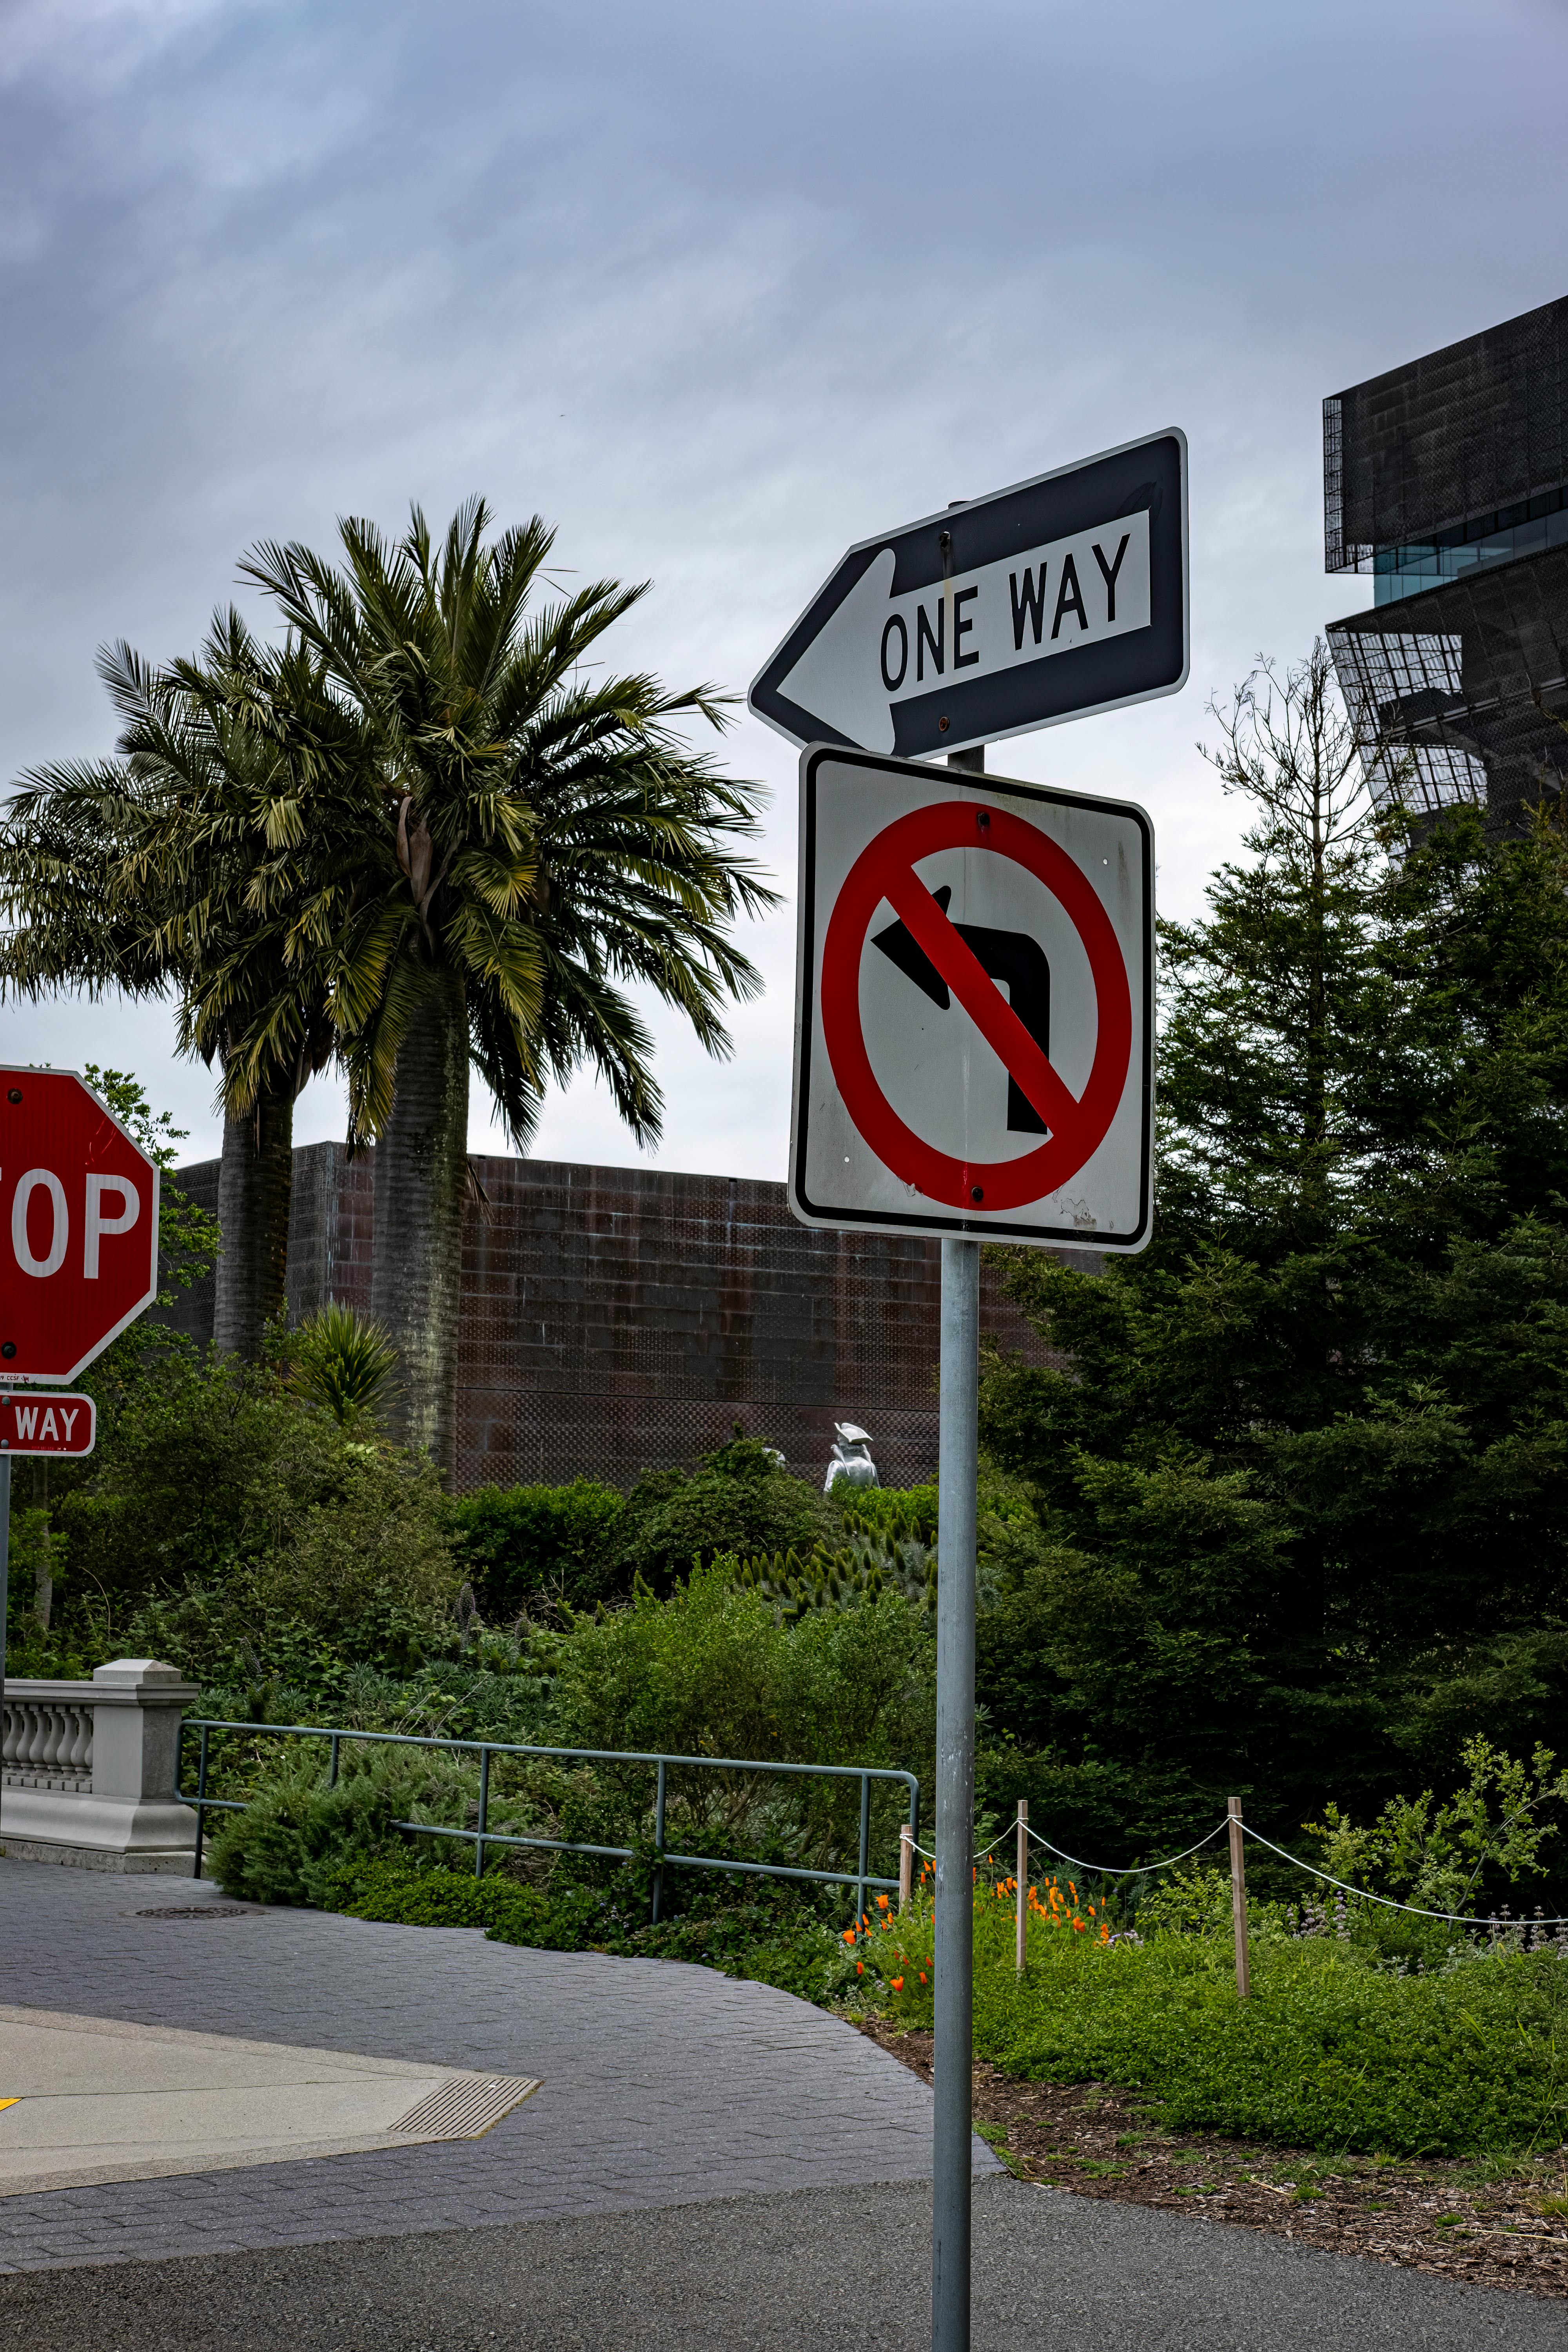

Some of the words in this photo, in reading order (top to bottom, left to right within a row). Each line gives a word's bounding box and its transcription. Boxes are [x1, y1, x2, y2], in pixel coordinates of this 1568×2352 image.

[880, 585, 979, 691] ONE
[1009, 534, 1131, 651] WAY
[0, 1167, 140, 1279] OP
[15, 1406, 79, 1441] WAY
